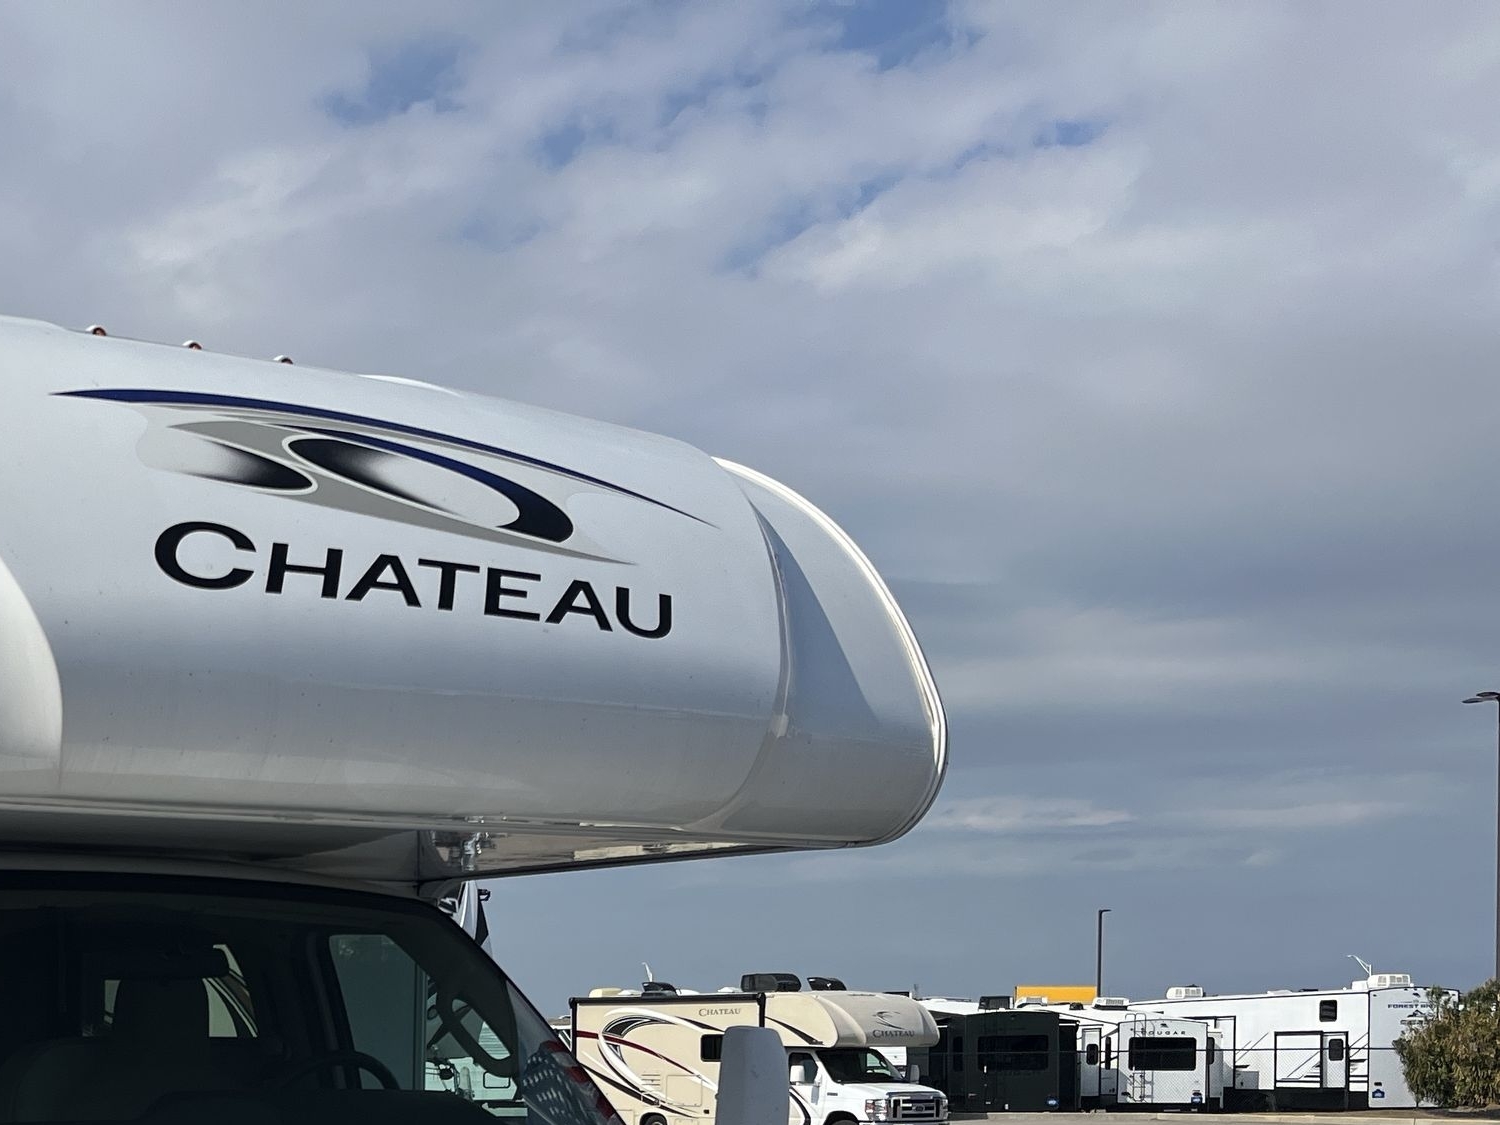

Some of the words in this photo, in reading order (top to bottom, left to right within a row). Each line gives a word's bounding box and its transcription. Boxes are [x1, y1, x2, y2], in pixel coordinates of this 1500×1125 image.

[154, 520, 673, 639] CHATEAU
[698, 1008, 741, 1017] CHATEAU
[872, 1029, 915, 1038] CHATEAU
